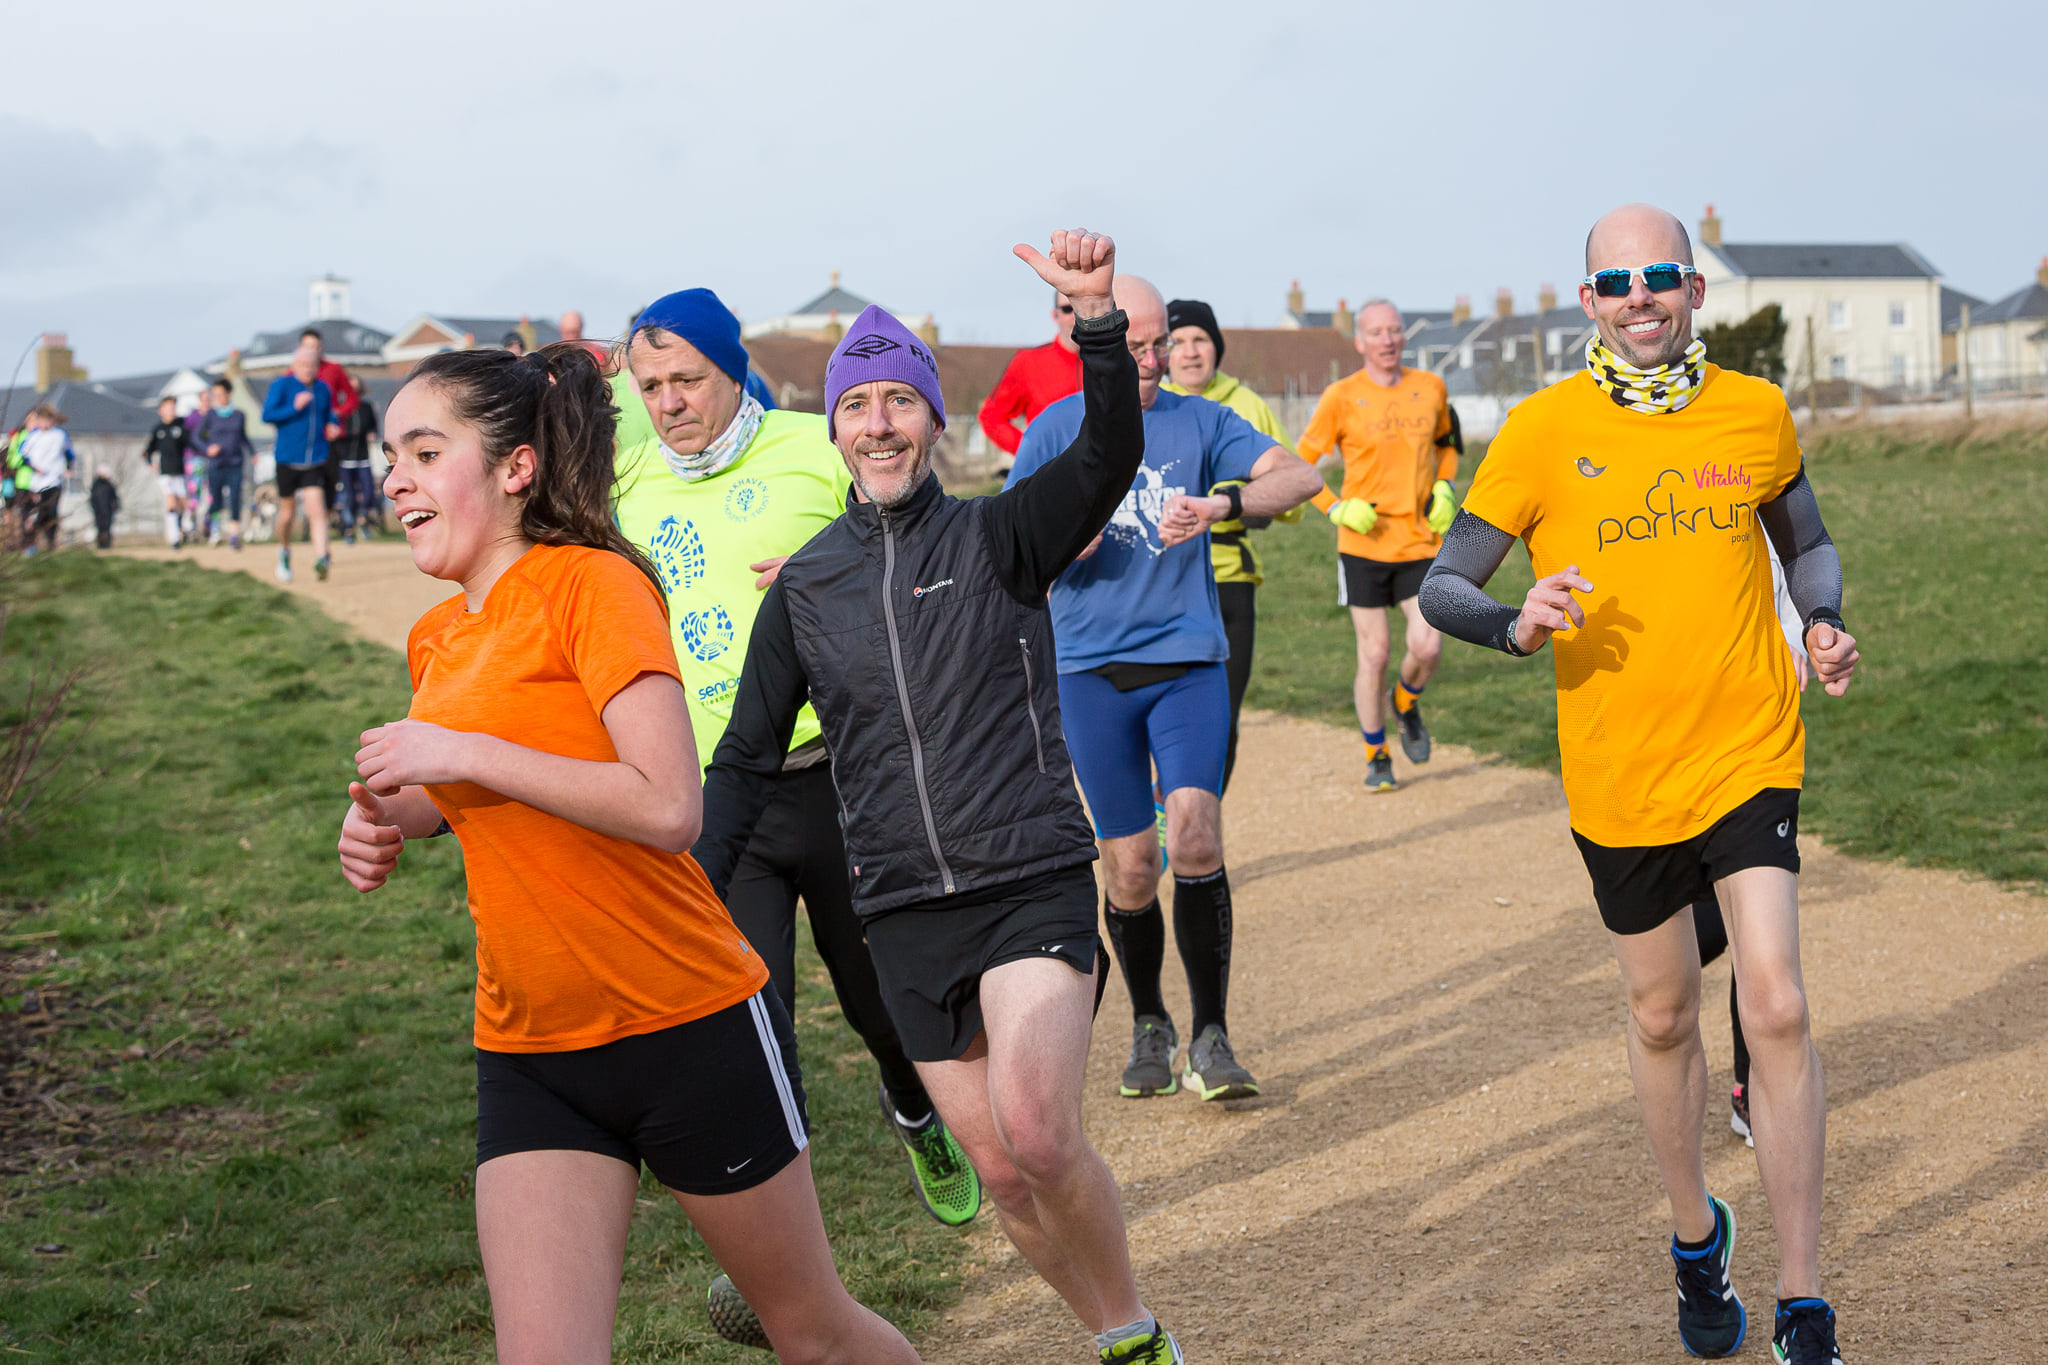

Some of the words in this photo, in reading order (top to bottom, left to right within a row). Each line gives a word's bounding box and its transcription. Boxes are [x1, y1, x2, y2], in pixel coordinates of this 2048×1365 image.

[725, 477, 768, 502] OAKHAVEN
[1693, 461, 1751, 494] Vitality
[1597, 493, 1751, 552] parkrun
